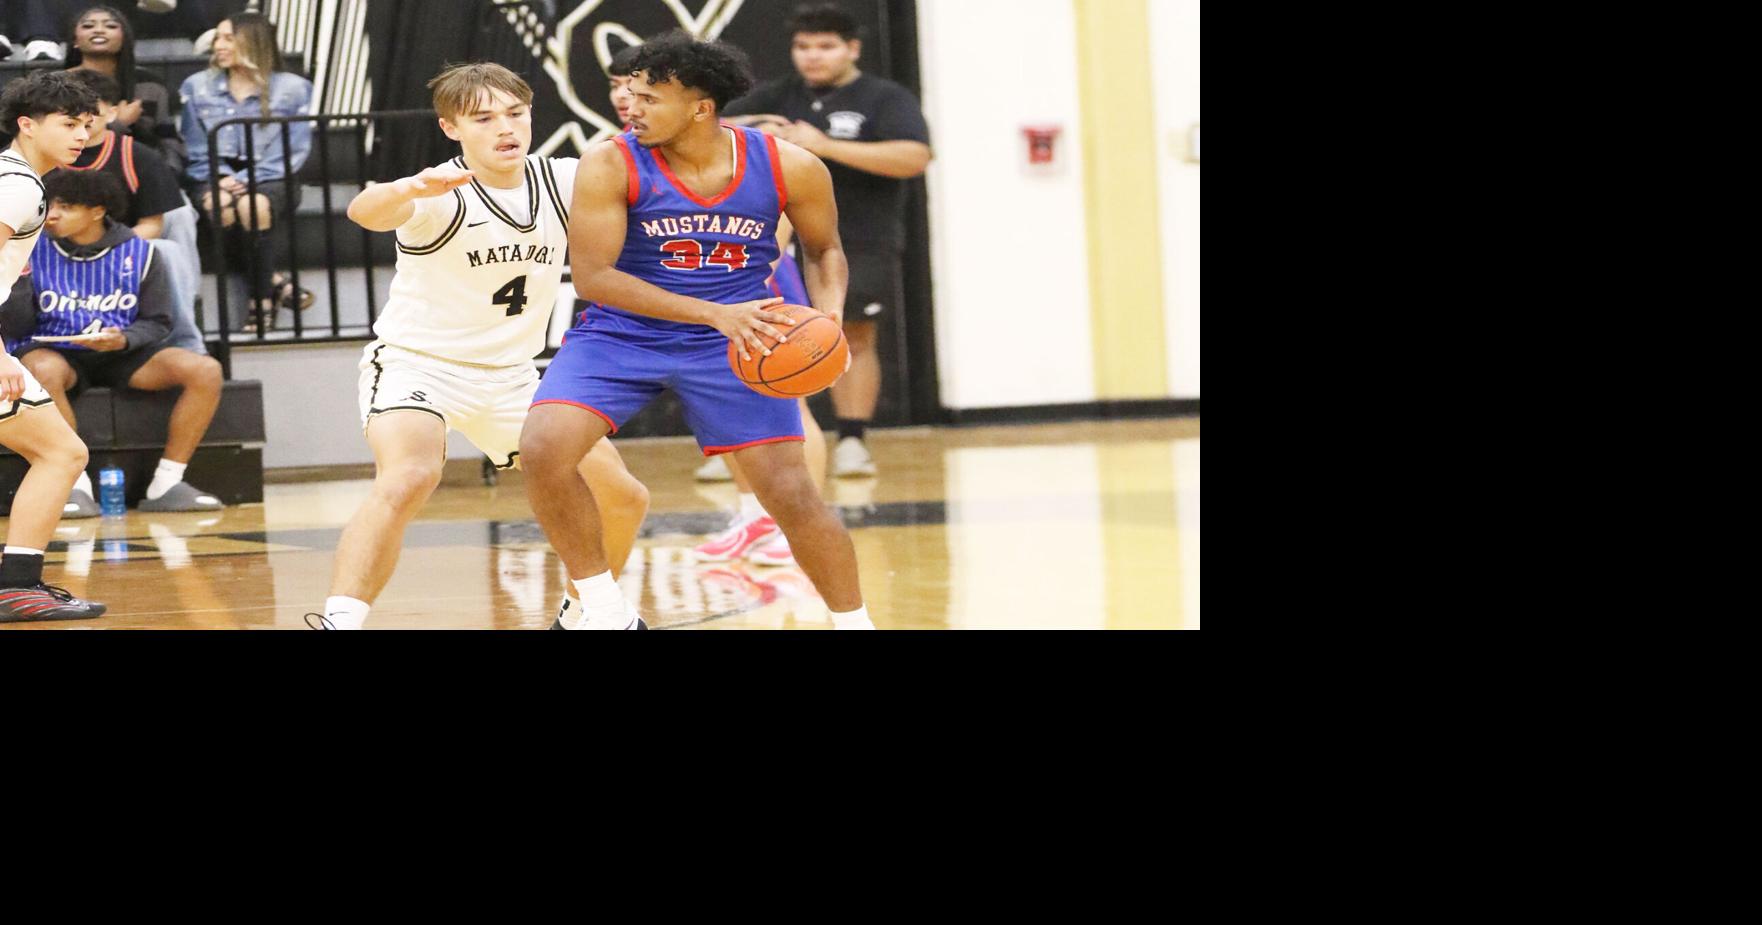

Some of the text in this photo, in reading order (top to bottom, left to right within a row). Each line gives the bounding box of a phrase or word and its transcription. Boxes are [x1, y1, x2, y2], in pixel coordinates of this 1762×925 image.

[640, 214, 765, 240] MUSTANGS
[466, 244, 554, 268] MATADOR
[660, 239, 750, 272] 34
[492, 275, 528, 316] 4
